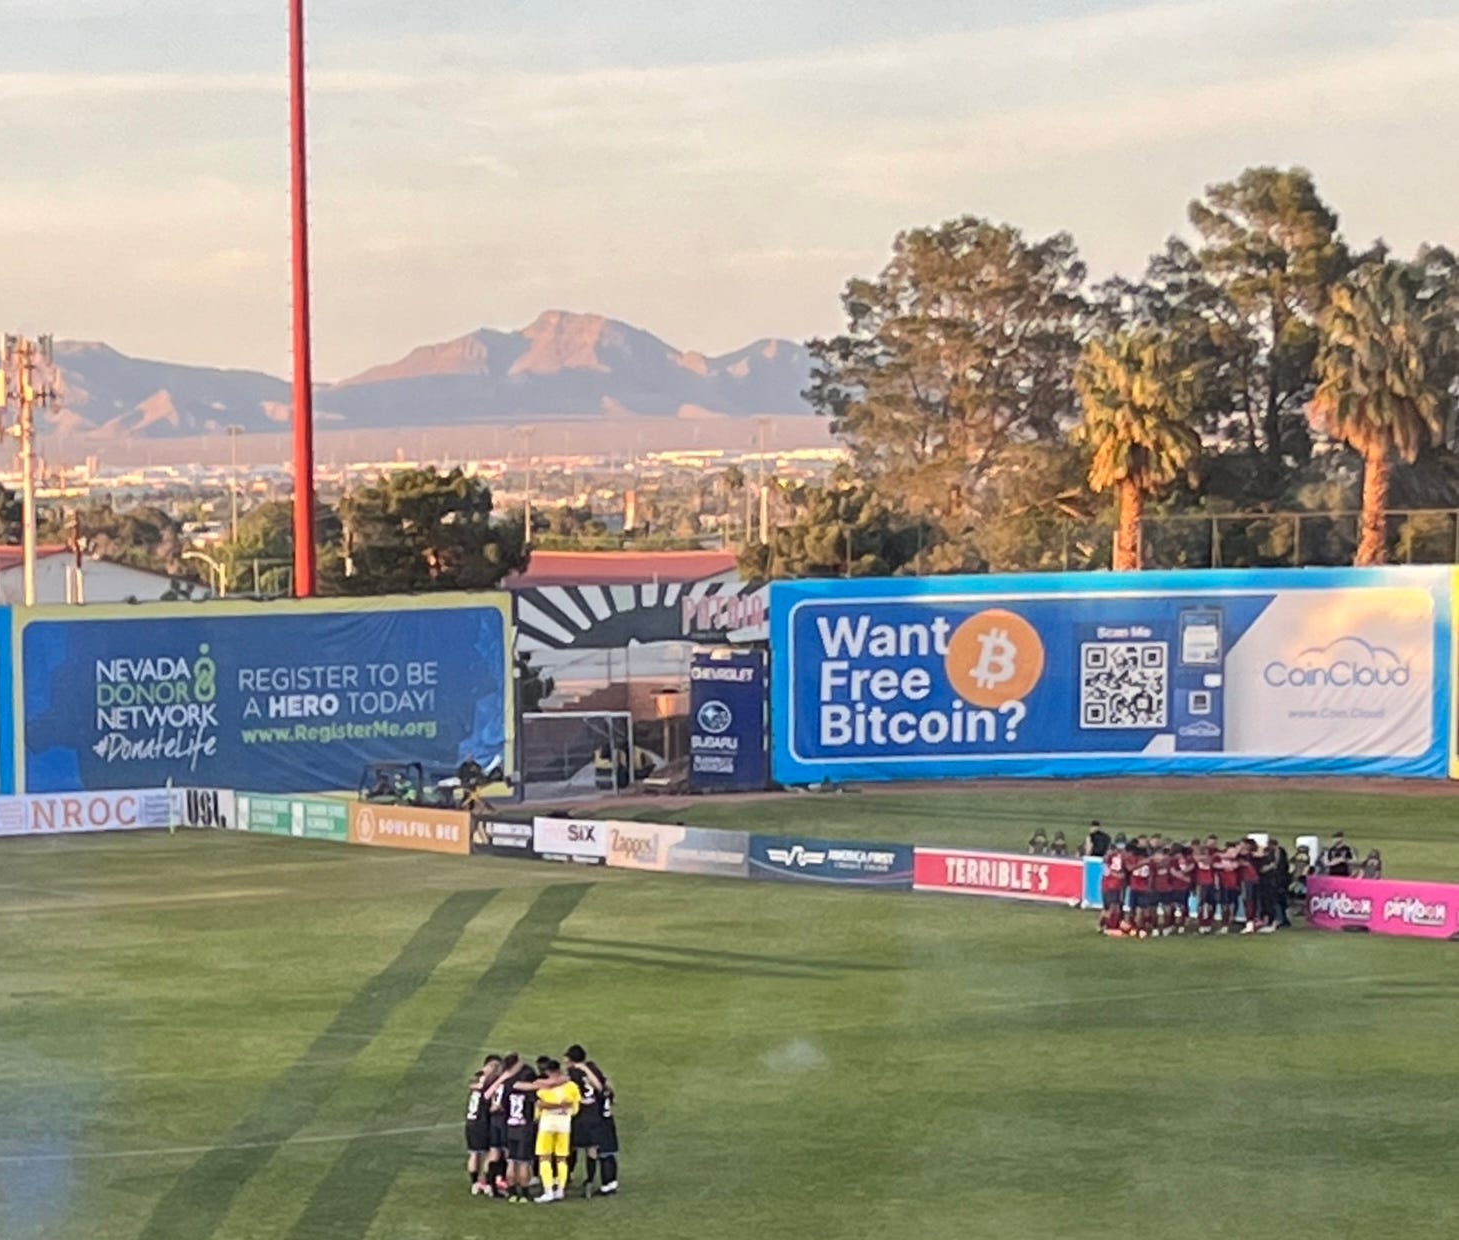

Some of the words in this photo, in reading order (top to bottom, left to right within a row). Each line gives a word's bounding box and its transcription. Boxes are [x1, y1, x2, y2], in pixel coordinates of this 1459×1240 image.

[817, 615, 951, 658] Want
[96, 657, 191, 683] NEVADA
[238, 666, 359, 691] REGISTER
[366, 664, 399, 687] TO
[406, 662, 438, 686] BE
[820, 660, 931, 701] Free
[1263, 660, 1411, 688] CoinCloud
[97, 681, 190, 707] DONOR
[243, 696, 262, 720] A
[268, 693, 339, 718] HERO
[346, 689, 435, 714] TODAY!
[97, 703, 219, 730] NETWORK
[819, 699, 1026, 746] Bitcoin?
[241, 720, 437, 744] www.RegisterMe.org
[93, 725, 217, 772] #DonateLife
[31, 796, 137, 829] NROC
[378, 818, 432, 839] SOULFUL
[945, 856, 1049, 891] TERRIBLE'S
